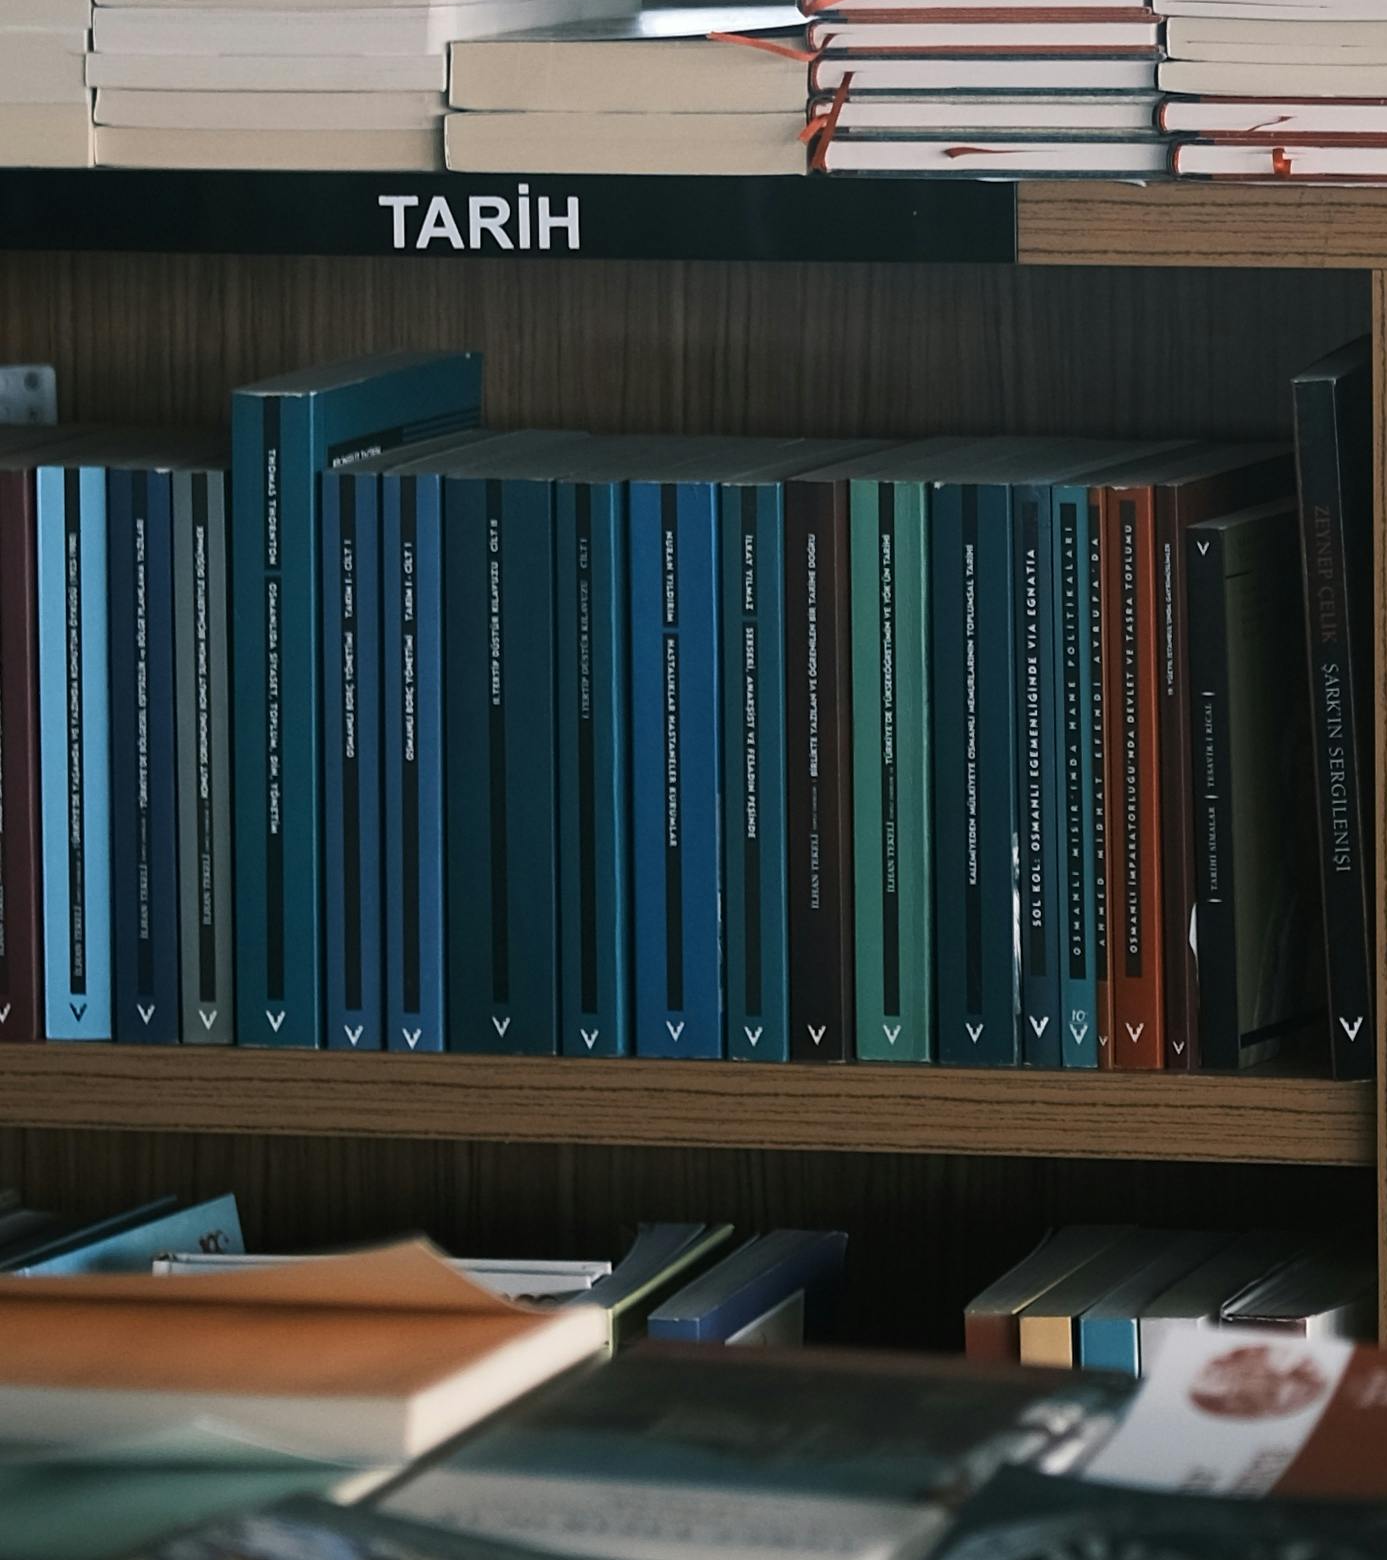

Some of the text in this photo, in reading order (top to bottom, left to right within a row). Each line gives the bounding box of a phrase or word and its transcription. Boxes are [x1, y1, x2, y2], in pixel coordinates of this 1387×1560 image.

[378, 183, 580, 249] TARİH
[1025, 548, 1042, 927] SOL KOL: OSMANLI EGEMENLİĞİNDE VIA EGNATIA
[1313, 505, 1353, 873] ZEYNEP ÇELİK ŞARK'IN SERGİLENİŞİ
